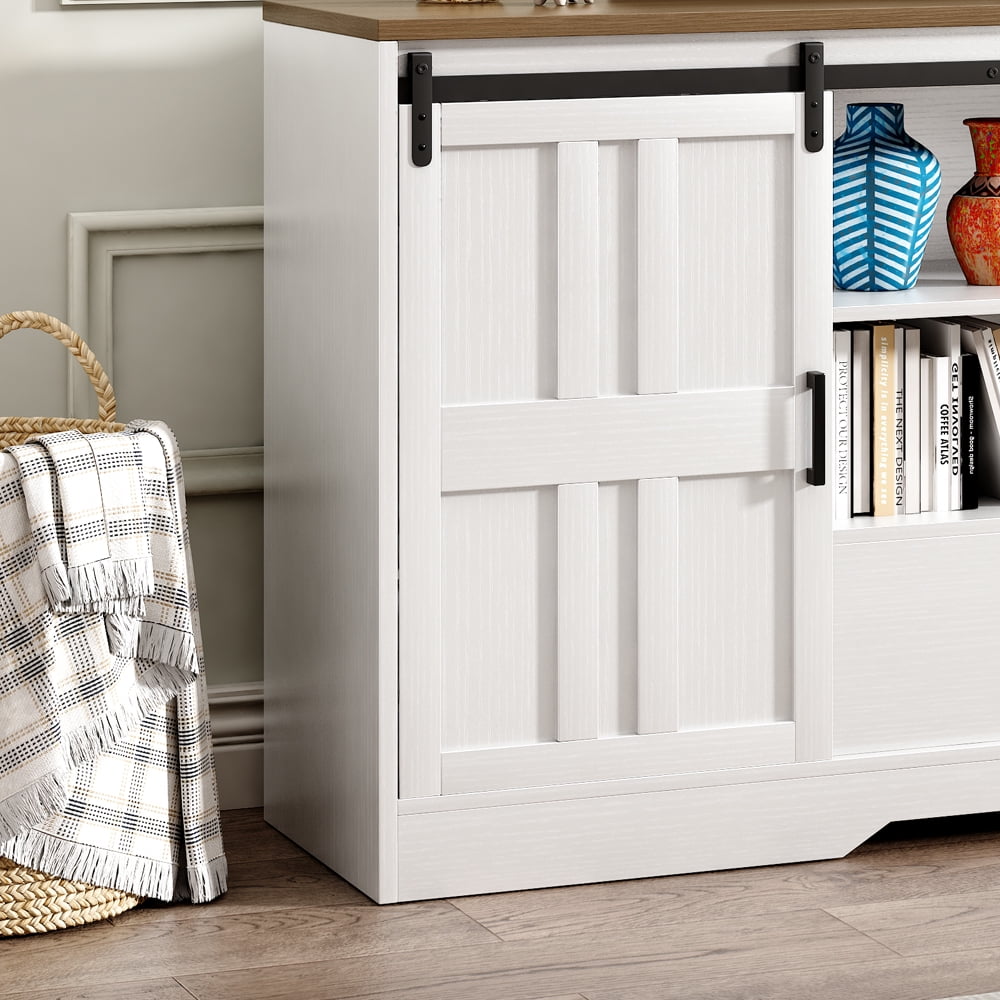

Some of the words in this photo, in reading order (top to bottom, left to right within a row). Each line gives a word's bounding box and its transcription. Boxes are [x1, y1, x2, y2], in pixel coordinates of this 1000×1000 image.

[879, 336, 889, 387] simplicity
[838, 360, 848, 416] PROTECT
[895, 388, 903, 414] THE
[838, 419, 848, 447] OUR
[895, 418, 903, 452] NEXT
[940, 403, 949, 436] COFFEE
[879, 415, 889, 469] everything
[940, 438, 949, 466] ATLAS
[838, 449, 848, 495] DESIGN
[895, 457, 903, 506] DESIGN
